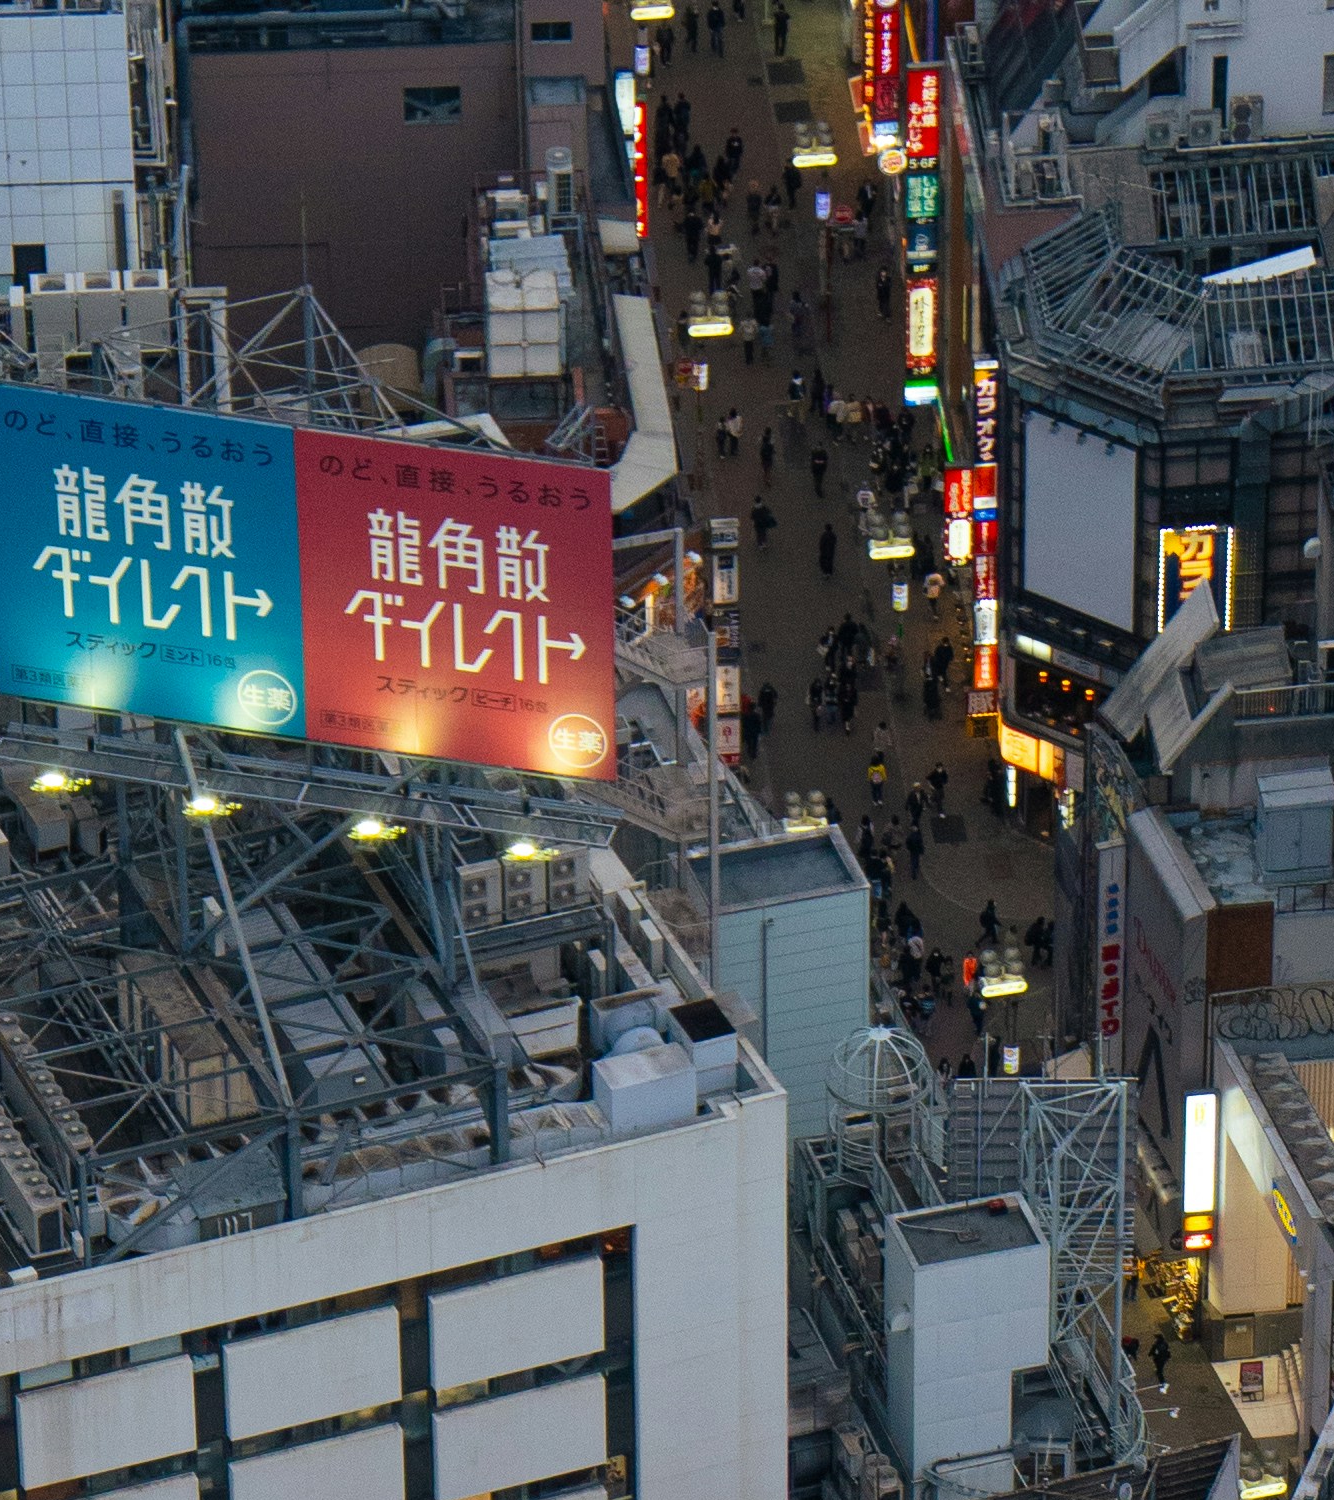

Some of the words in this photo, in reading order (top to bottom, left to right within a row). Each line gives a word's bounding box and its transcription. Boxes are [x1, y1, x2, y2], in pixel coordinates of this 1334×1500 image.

[3, 408, 274, 468] のど、直接、うるおう
[976, 380, 997, 452] カラオケ
[53, 463, 236, 559] 龍角散
[318, 451, 592, 512] のど、直接、うるおう
[367, 508, 550, 603] 龍角散
[31, 544, 274, 642] ダイレクト
[65, 630, 156, 660] スティック
[343, 589, 587, 685] ダイレクト
[240, 682, 292, 714] 生薬
[375, 673, 467, 705] スティック
[552, 726, 605, 754] 生薬
